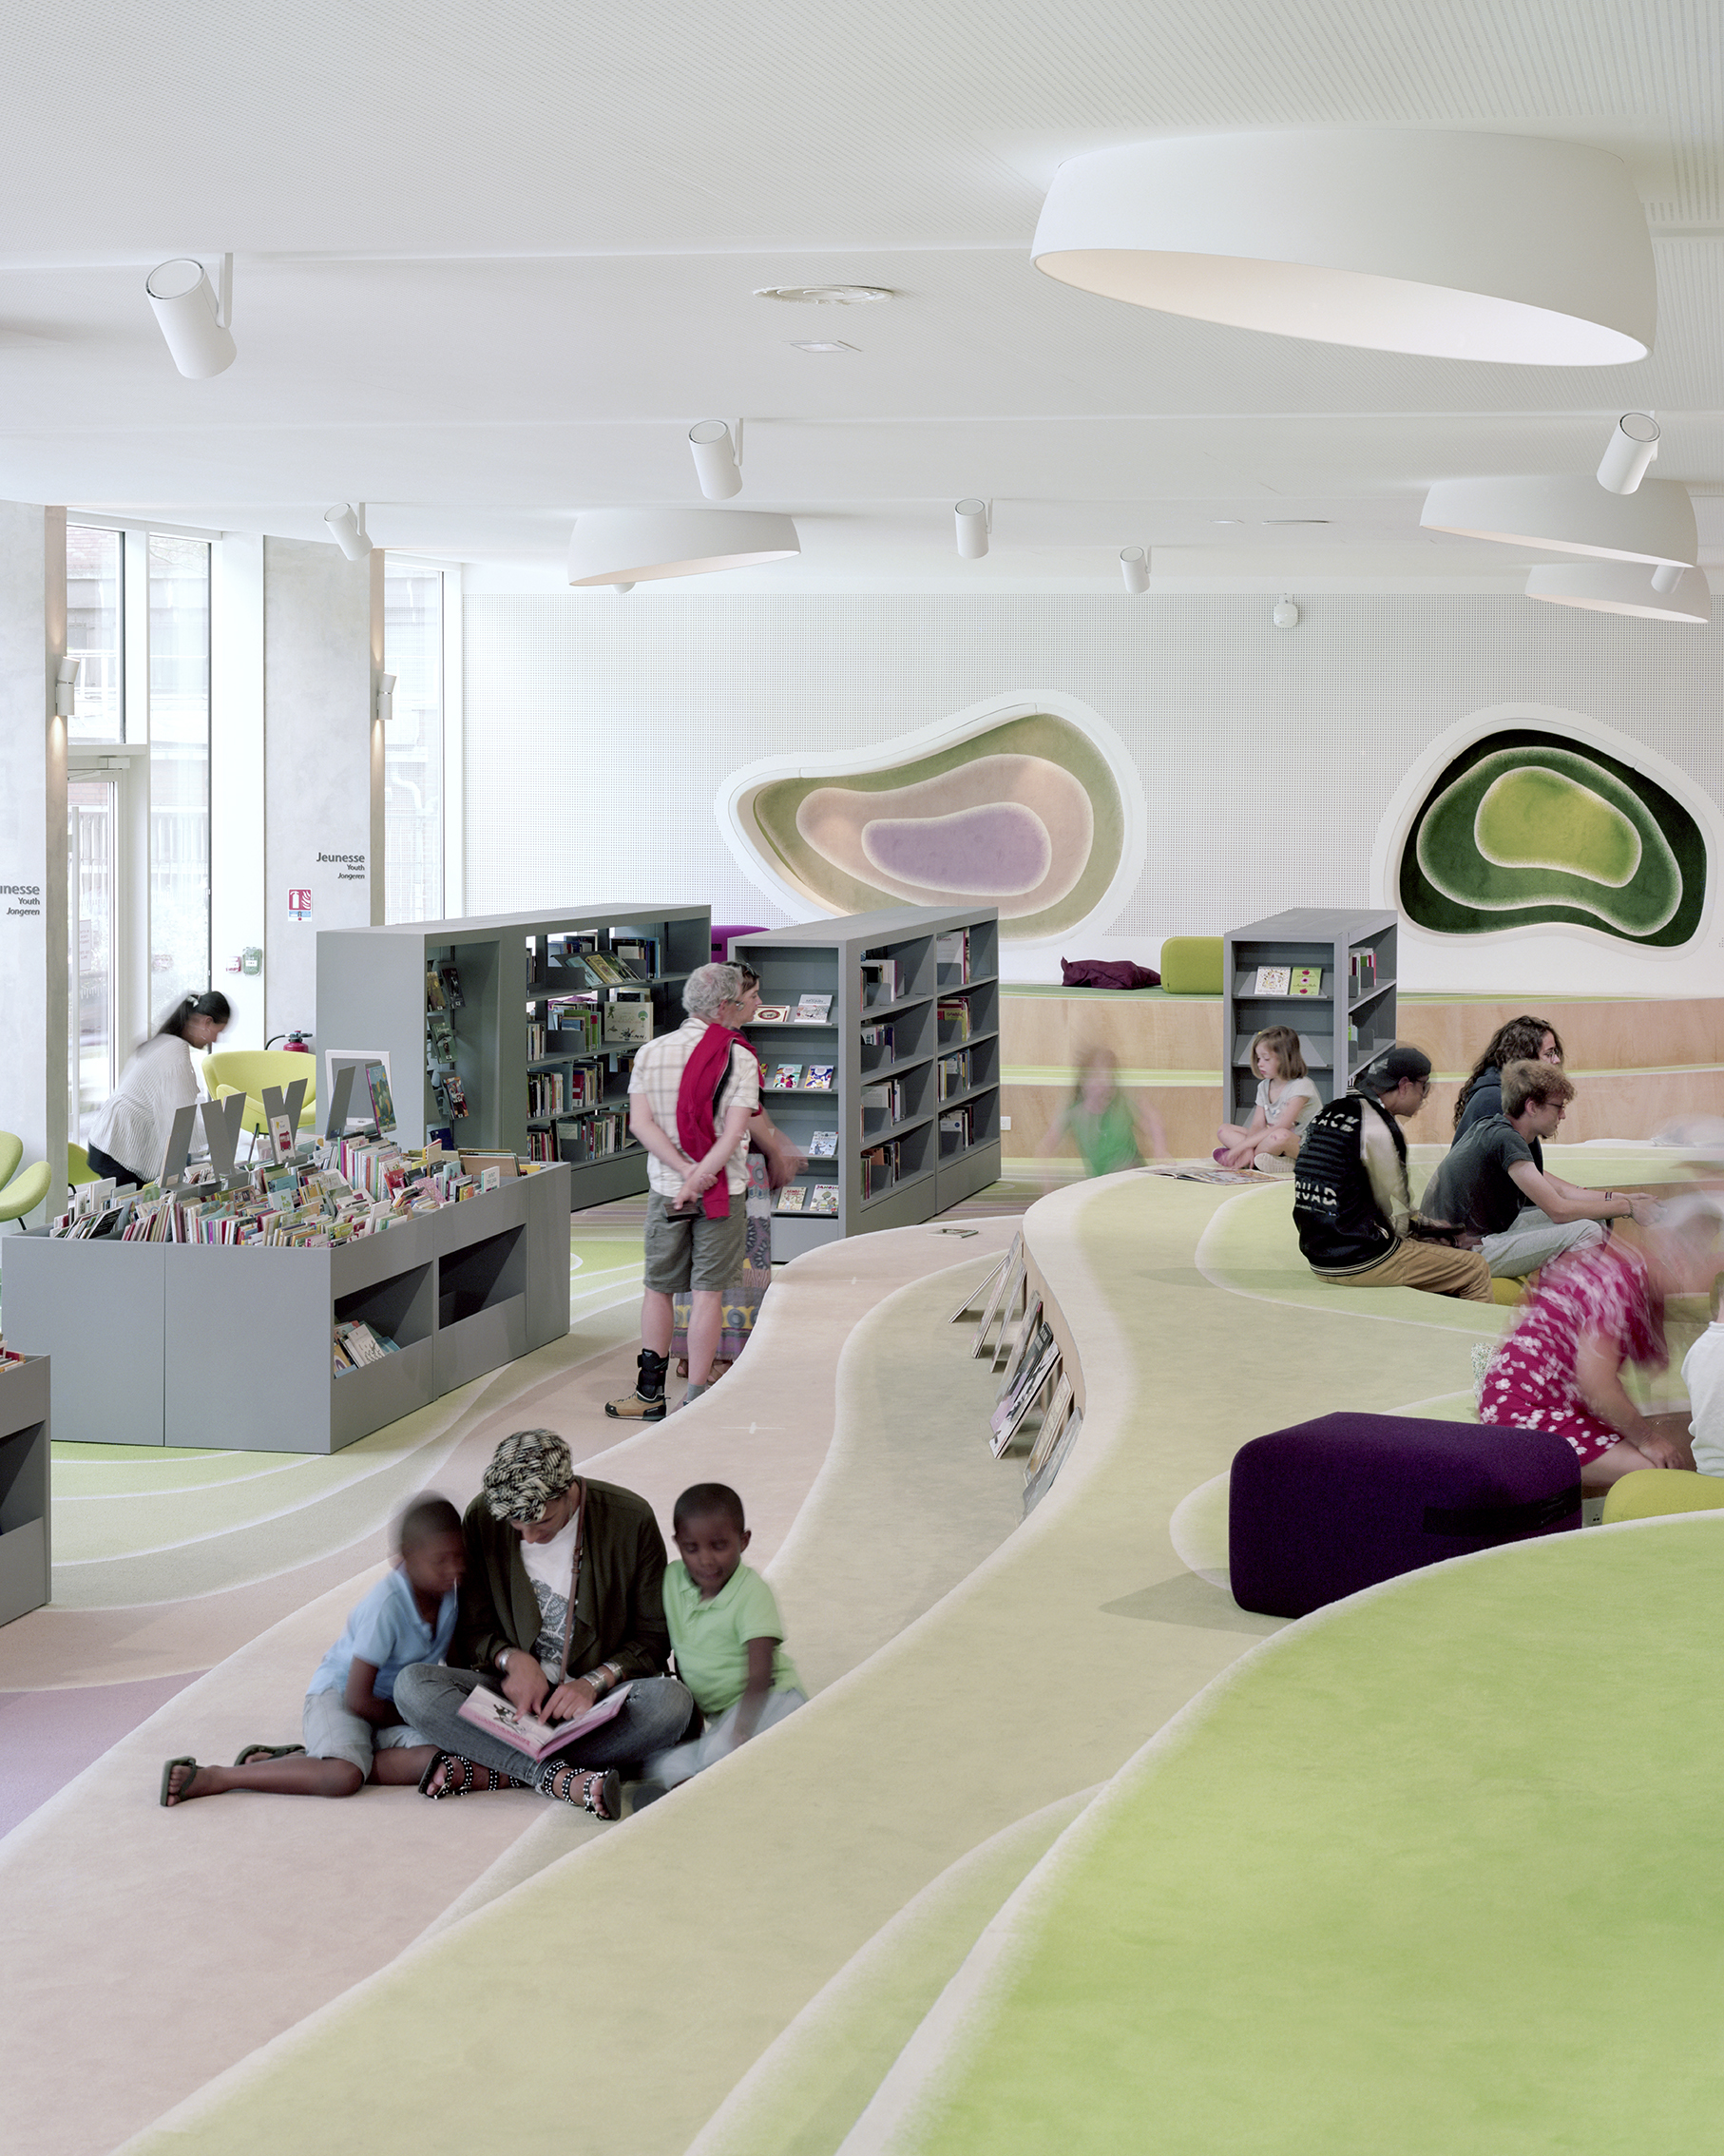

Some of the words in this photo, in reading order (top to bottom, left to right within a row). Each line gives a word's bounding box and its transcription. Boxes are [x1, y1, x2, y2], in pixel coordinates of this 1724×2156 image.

[316, 852, 366, 863] Jeunesse
[346, 863, 366, 872] Youth
[337, 872, 366, 881] Jongeren
[17, 896, 41, 906] Youth
[6, 906, 41, 917] Jongeren
